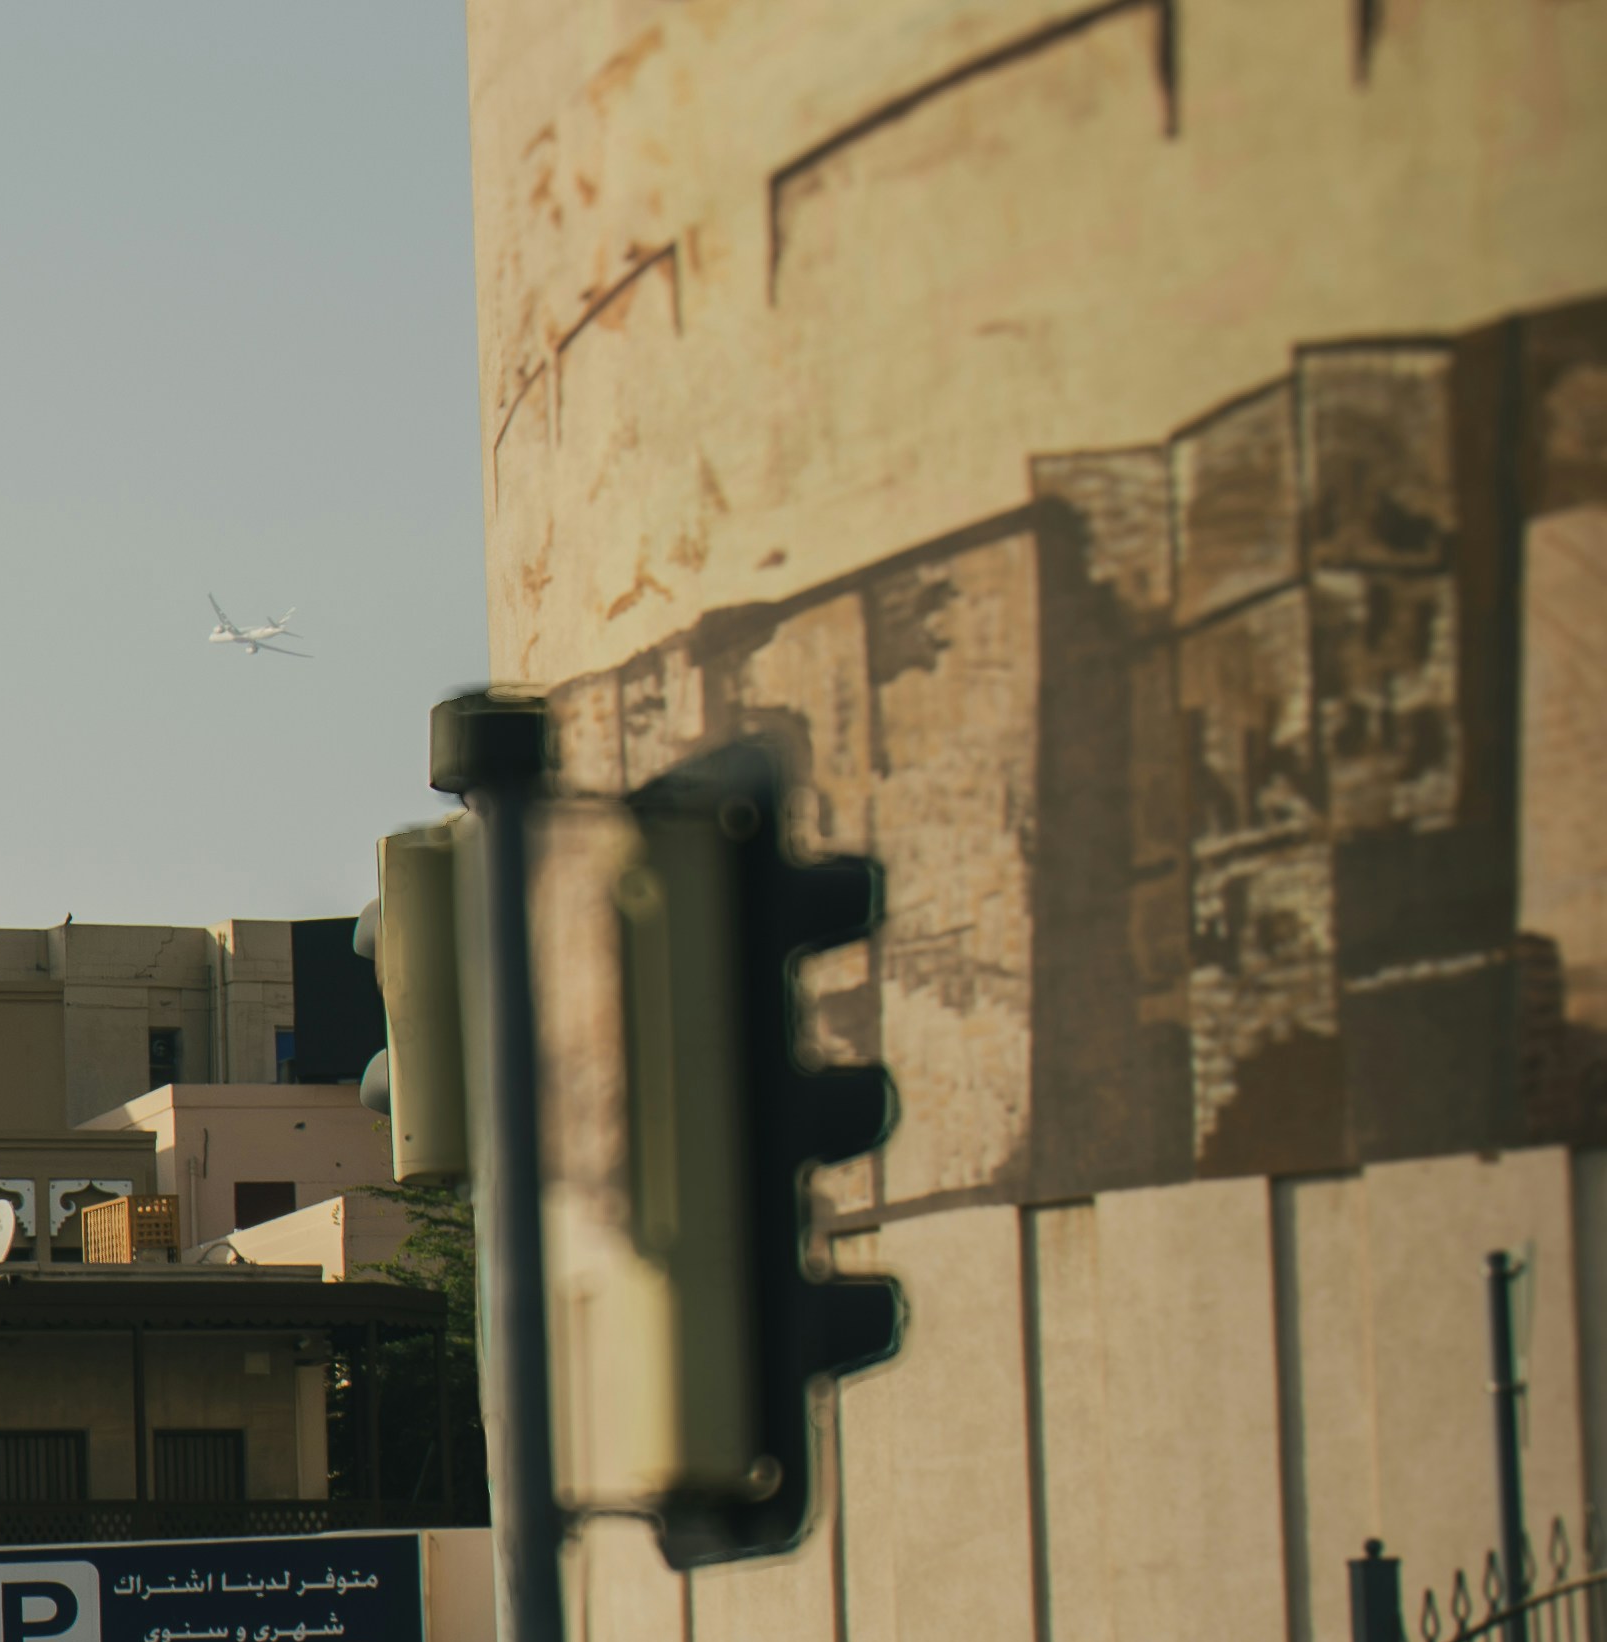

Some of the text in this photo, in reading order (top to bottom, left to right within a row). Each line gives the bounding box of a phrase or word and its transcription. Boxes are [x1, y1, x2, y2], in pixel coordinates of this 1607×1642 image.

[114, 1566, 379, 1600] متوفر لدينا اشتراك
[236, 1625, 247, 1642] و
